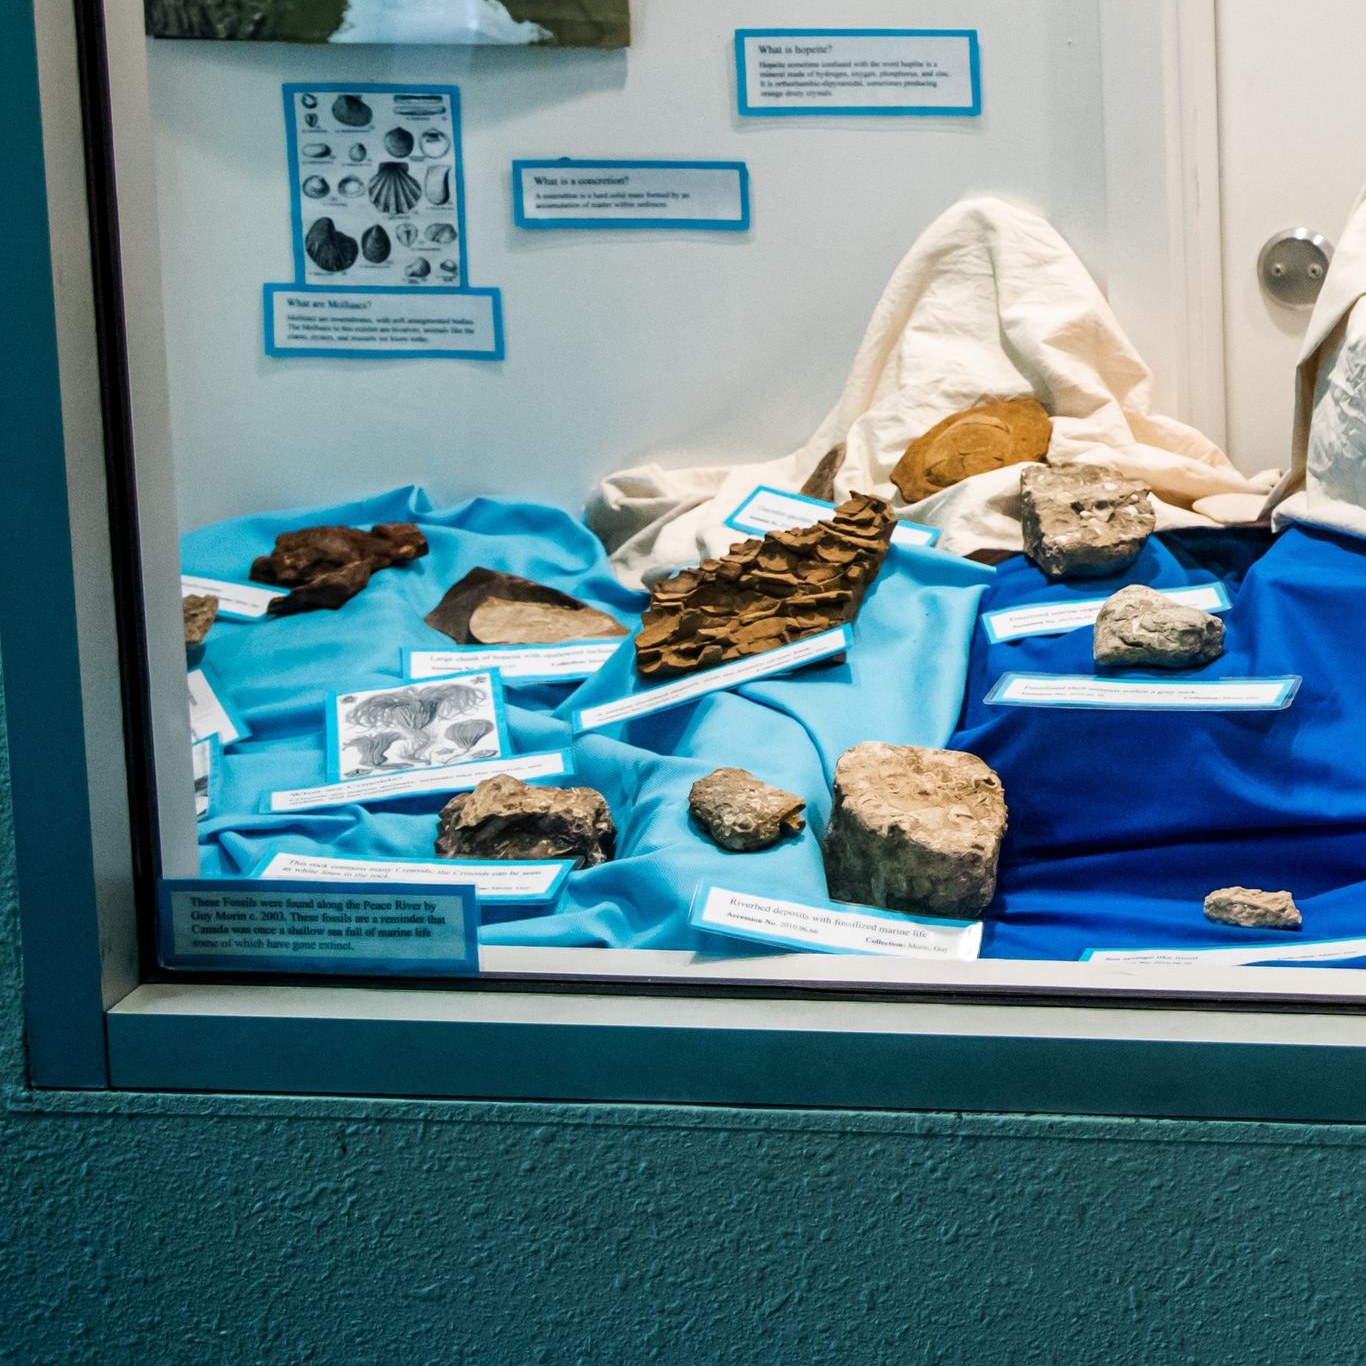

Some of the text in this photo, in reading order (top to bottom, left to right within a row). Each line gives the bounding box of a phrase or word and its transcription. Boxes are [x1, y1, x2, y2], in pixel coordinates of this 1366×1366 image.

[190, 896, 220, 907] These
[222, 896, 257, 907] Fossils
[285, 897, 314, 908] found
[315, 898, 344, 912] along
[345, 898, 360, 910] the
[363, 899, 392, 911] Peace
[394, 899, 421, 910] River
[423, 900, 436, 913] by
[729, 897, 932, 937] Riverbed deposits with fossilized marine life.
